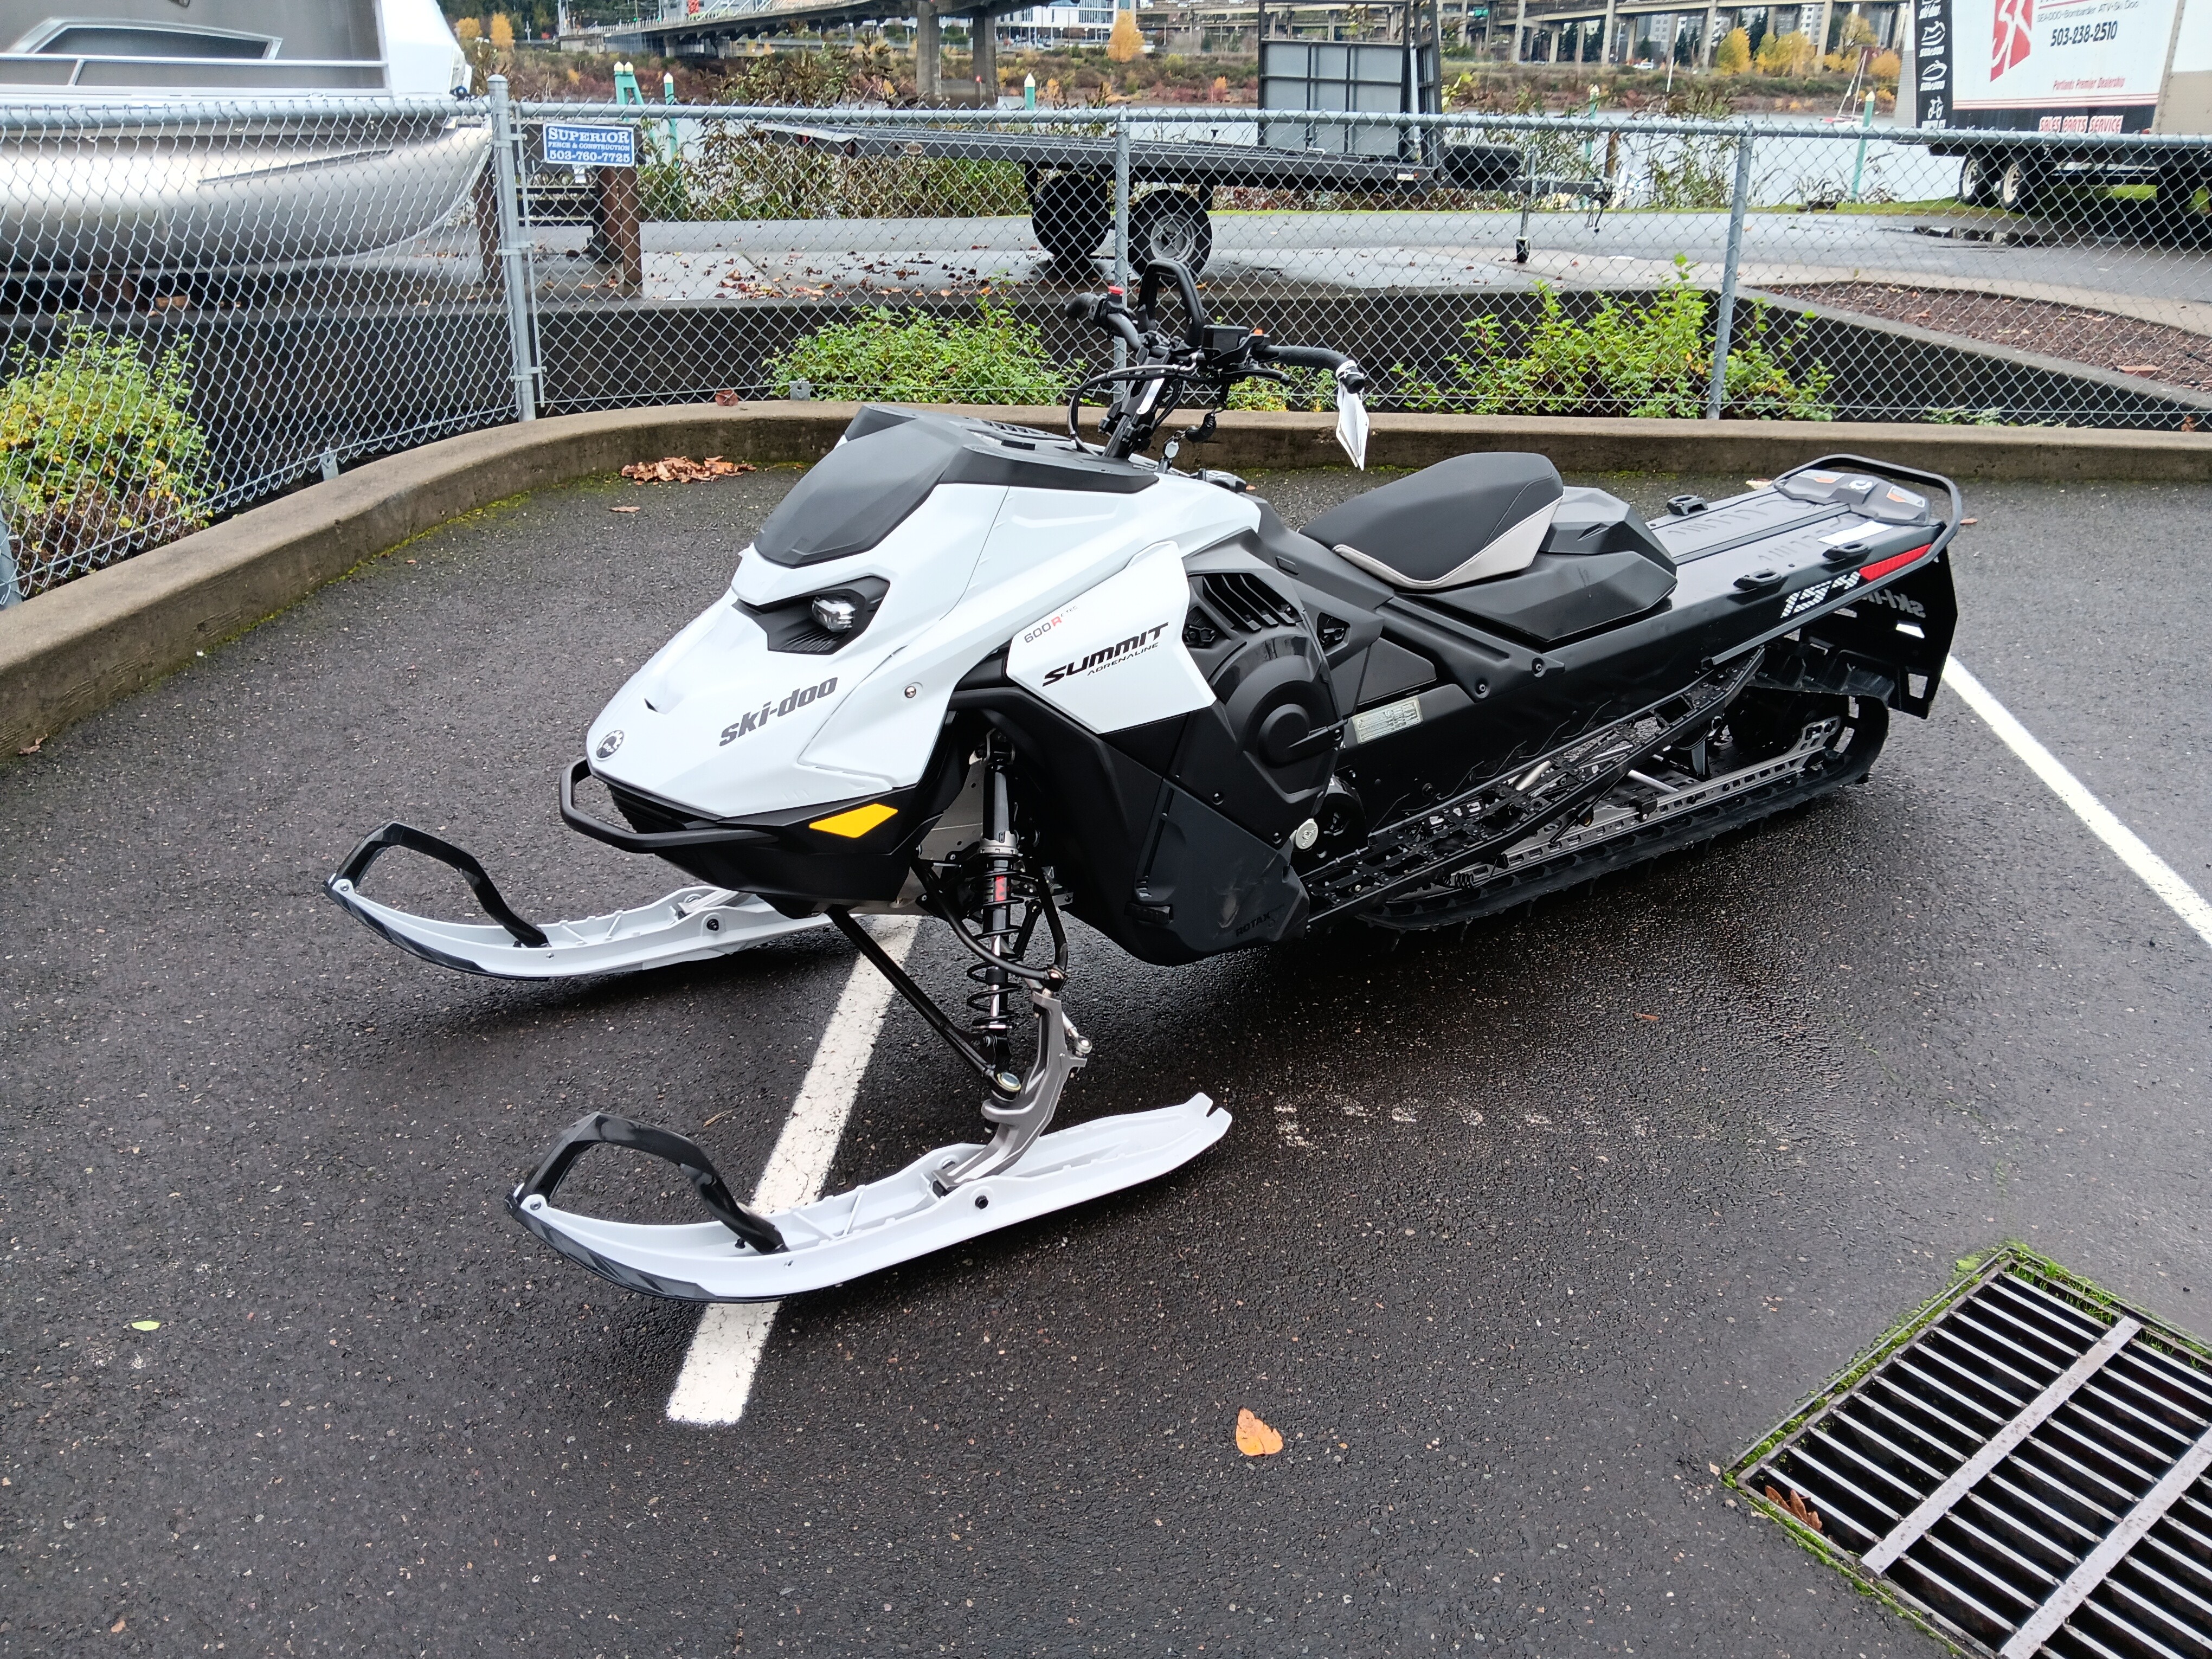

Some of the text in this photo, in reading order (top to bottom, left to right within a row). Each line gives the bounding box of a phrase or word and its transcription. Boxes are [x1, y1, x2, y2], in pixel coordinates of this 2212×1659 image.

[2050, 21, 2118, 47] 503-238-2510
[548, 127, 629, 144] SUPERIOR
[2039, 116, 2123, 133] SALES PARTS SERVICE
[549, 150, 630, 163] 503-760-7725
[1042, 622, 1168, 687] SUMMIT
[1087, 642, 1159, 676] ADRENALINE
[719, 677, 838, 747] ski-doo
[1236, 911, 1271, 937] ROTAX
